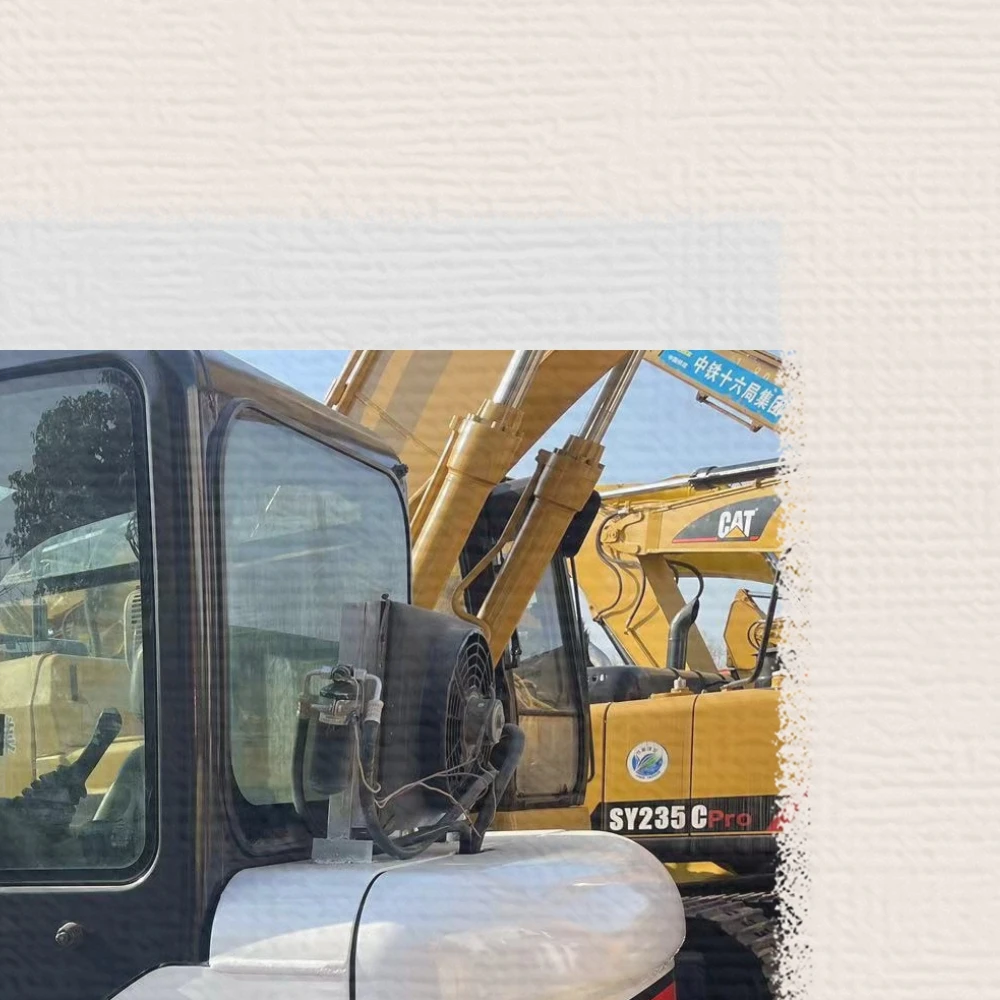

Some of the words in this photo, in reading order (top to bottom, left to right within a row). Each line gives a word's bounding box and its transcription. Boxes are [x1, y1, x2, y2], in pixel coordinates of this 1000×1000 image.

[693, 355, 785, 417] 中铁十六局集团
[717, 510, 756, 539] CAT
[708, 808, 753, 829] Pro
